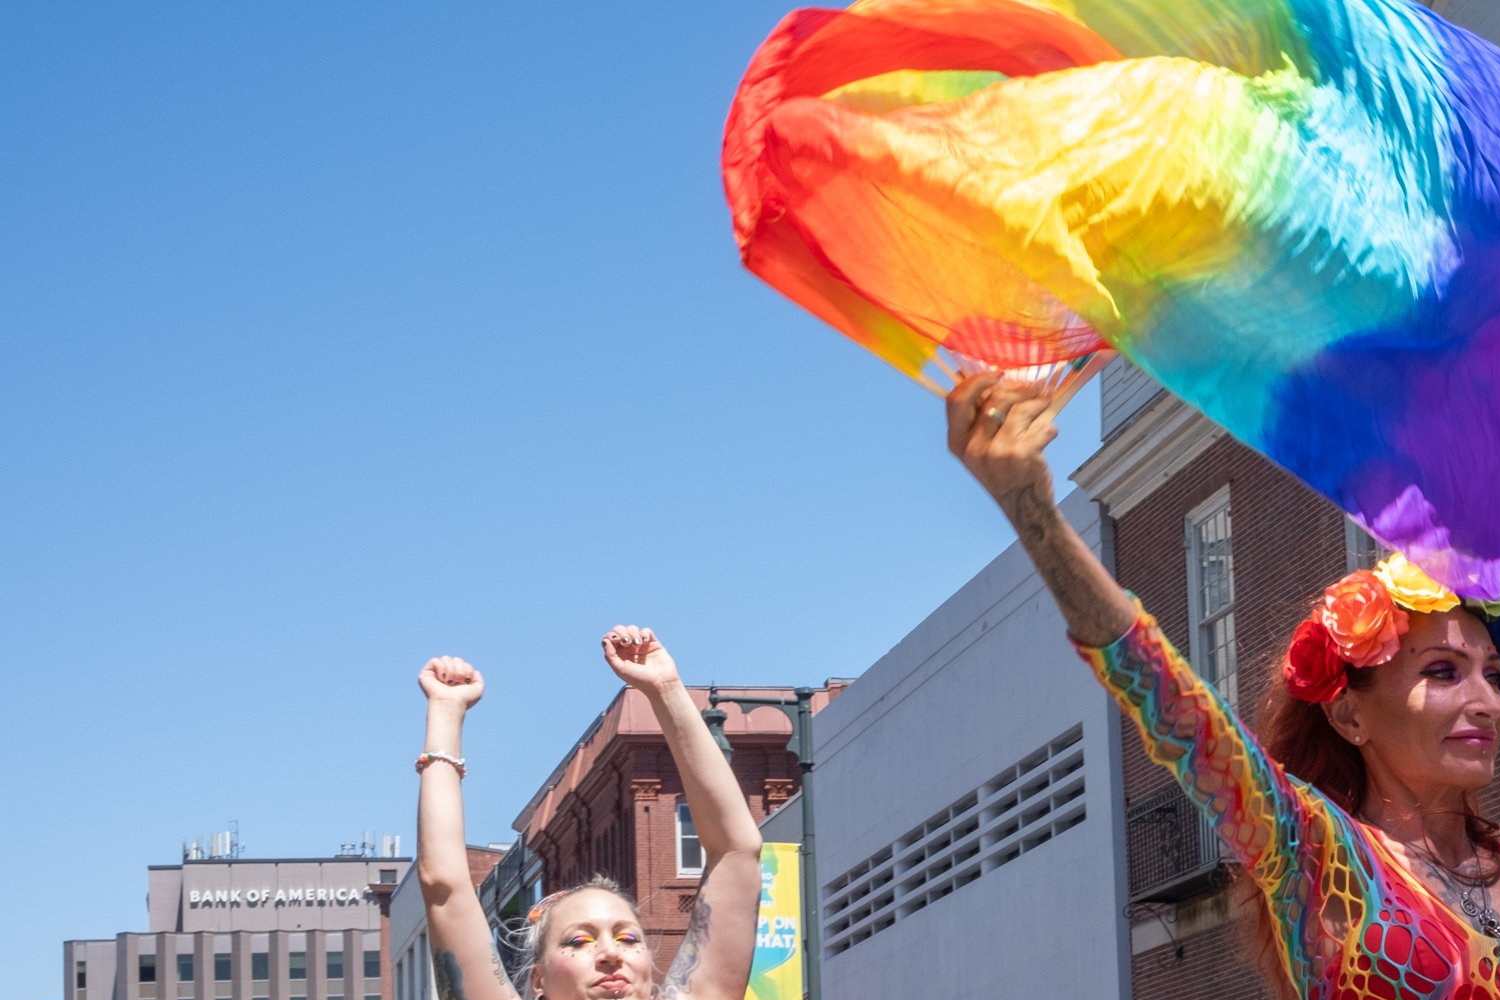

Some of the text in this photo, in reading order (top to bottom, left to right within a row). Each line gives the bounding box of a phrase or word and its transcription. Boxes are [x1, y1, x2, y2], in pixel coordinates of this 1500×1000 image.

[190, 887, 360, 903] BANK OF AMERICA
[773, 915, 796, 929] ON
[756, 933, 797, 949] HAT.
